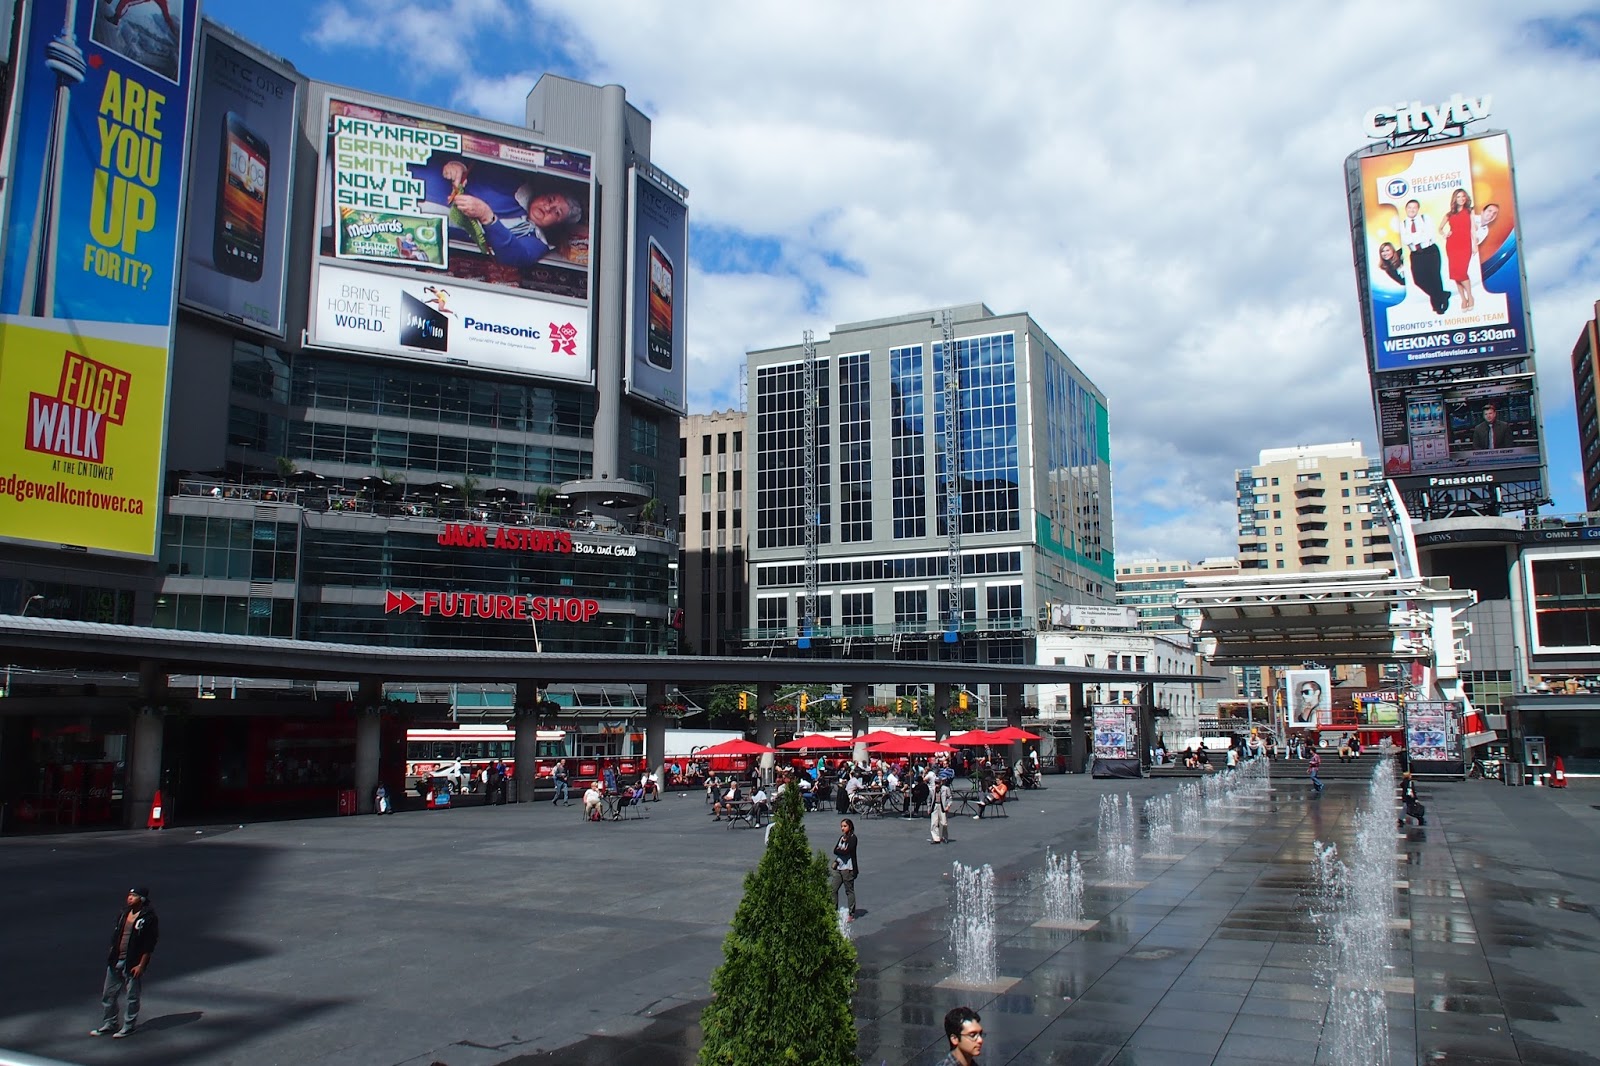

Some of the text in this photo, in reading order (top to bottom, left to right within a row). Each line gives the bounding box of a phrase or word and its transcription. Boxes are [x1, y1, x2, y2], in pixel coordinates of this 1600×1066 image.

[99, 70, 166, 140] ARE
[1363, 93, 1491, 138] Citytv
[338, 118, 458, 149] MAYNARDS
[98, 116, 162, 187] YOU
[338, 136, 428, 162] GRANNY
[338, 154, 409, 177] SMITH.
[338, 171, 421, 196] NOW ON
[1390, 183, 1404, 195] BT
[1411, 171, 1461, 186] BREAKFAST
[1412, 179, 1462, 193] TELEVISION
[89, 168, 157, 255] UP
[338, 189, 417, 212] SHELF.
[83, 244, 152, 290] FOR IT?
[341, 284, 380, 302] BRING
[328, 299, 391, 319] HOME THE
[335, 314, 386, 333] WORLD.
[464, 317, 541, 340] Panasonic
[1391, 321, 1433, 332] TORONTO'S
[1444, 315, 1480, 326] MORNING
[1483, 312, 1505, 322] TEAM
[1383, 328, 1516, 352] WEEKDAYS @ 5:30am
[1407, 348, 1478, 361] BreakfastTelevision.ca
[62, 356, 127, 420] EDGE
[33, 397, 103, 460] WALK
[52, 460, 114, 481] AT THE CN TOWER
[1429, 473, 1493, 487] Panasonic
[0, 474, 144, 515] edgewalkcntower.ca
[438, 523, 572, 554] JACK ASTOR'S
[1429, 532, 1451, 542] NEWS
[1545, 530, 1579, 539] OMNI.2
[574, 541, 594, 554] Bar
[596, 543, 612, 556] and
[422, 591, 600, 623] FUTURE SHOP
